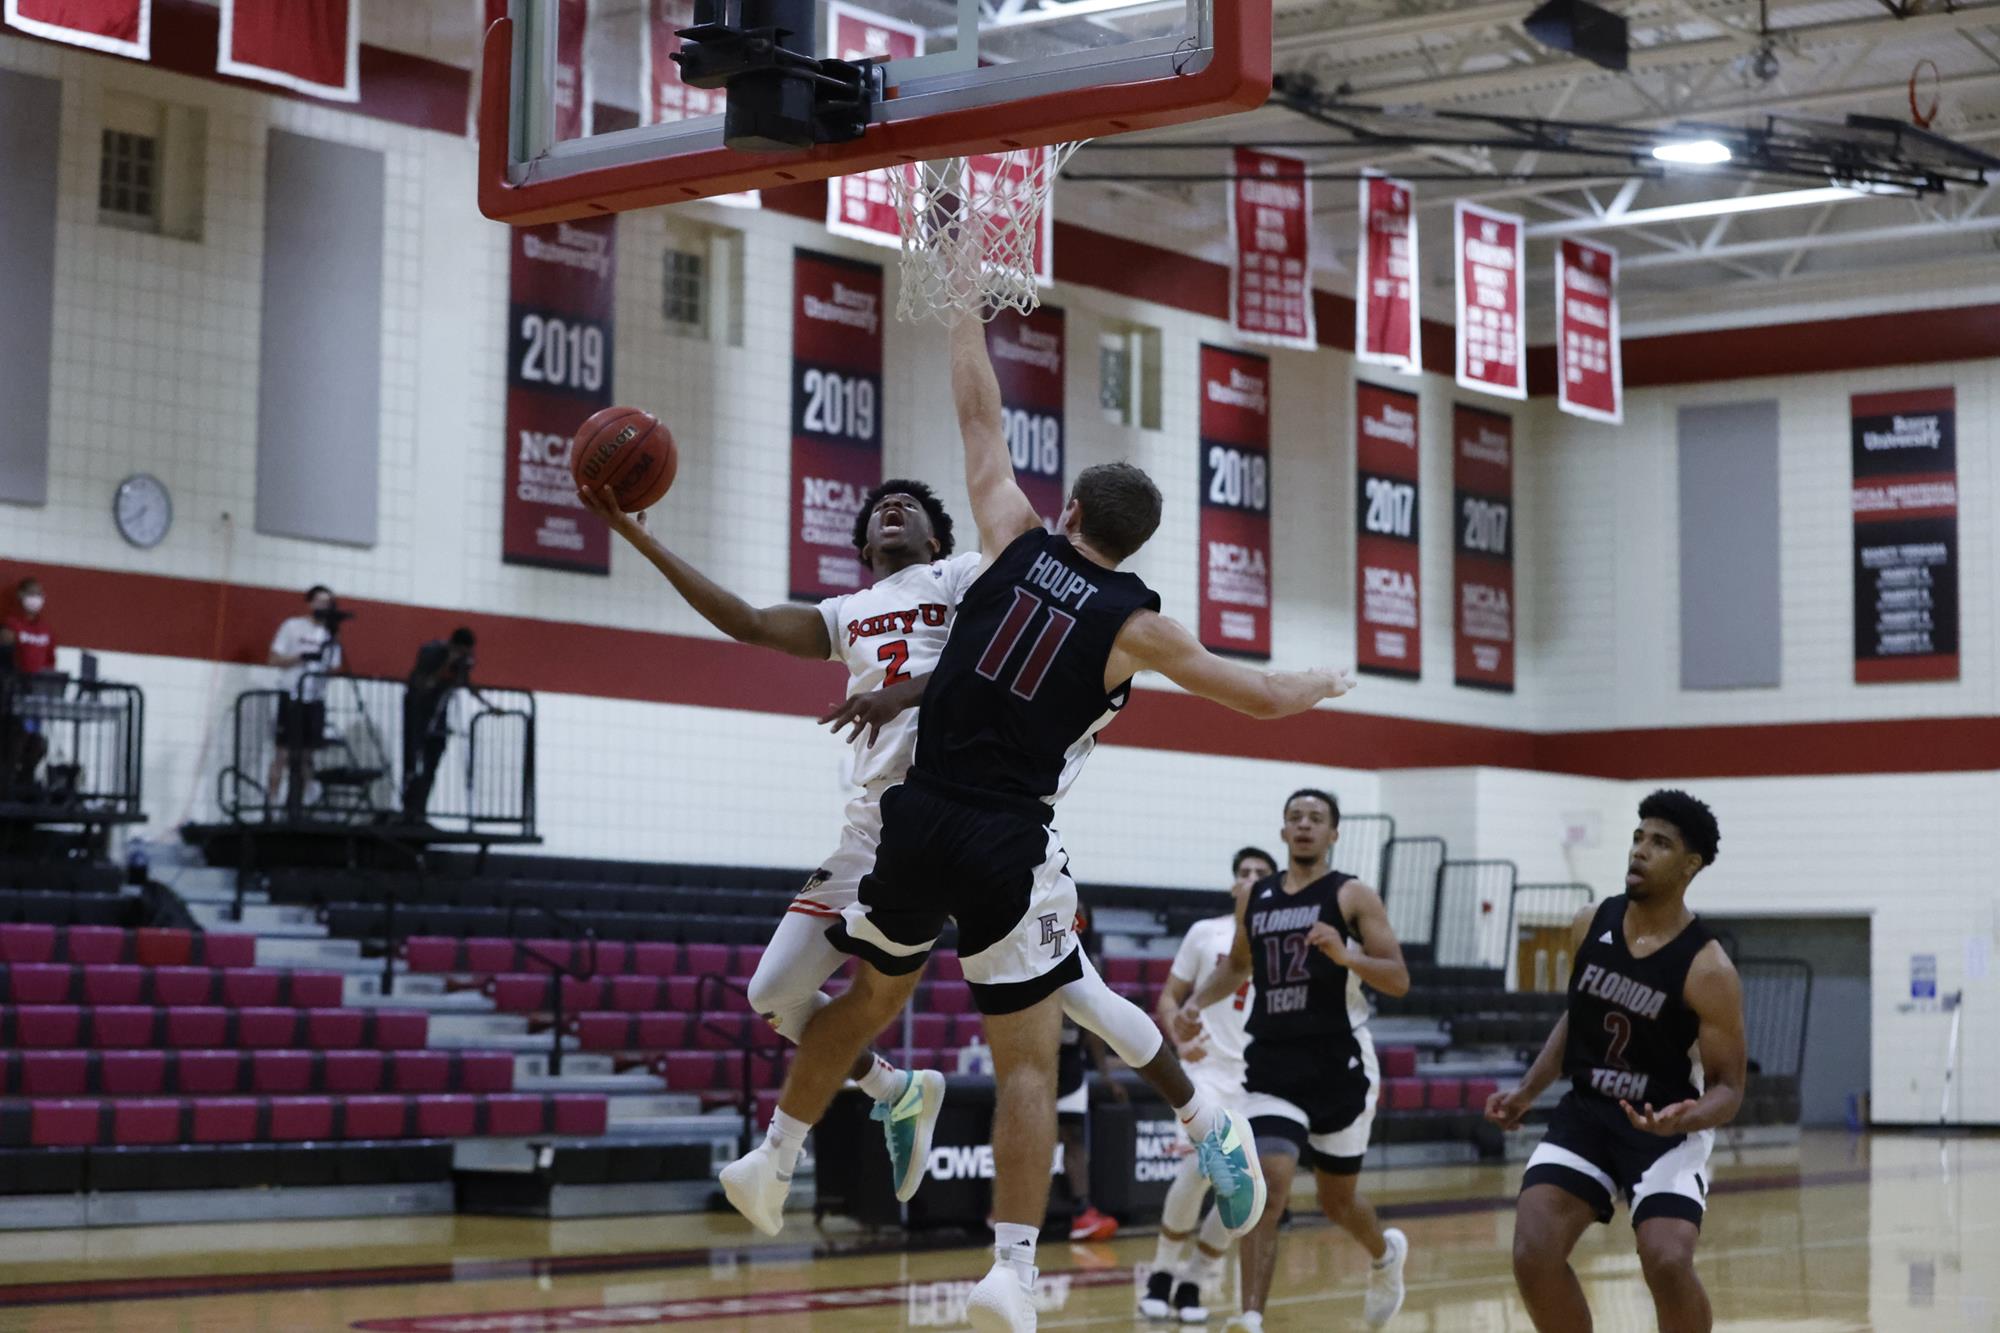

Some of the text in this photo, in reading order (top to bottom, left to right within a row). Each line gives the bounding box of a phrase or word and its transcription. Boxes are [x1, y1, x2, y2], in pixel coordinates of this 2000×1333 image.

[521, 313, 604, 392] 2019
[802, 368, 875, 440] 2019
[584, 424, 638, 481] Wilson
[1209, 446, 1267, 510] 2018
[1366, 478, 1414, 537] 2017
[1463, 499, 1508, 552] 2017
[1024, 551, 1098, 611] HOUPT
[877, 639, 912, 689] 2
[975, 585, 1077, 701] 11
[1037, 912, 1066, 960] FT
[1251, 903, 1322, 939] FLORIDA
[1263, 932, 1311, 986] 12
[1265, 985, 1309, 1015] TECH
[1577, 963, 1668, 1020] FLORIDA
[1603, 1011, 1632, 1070] 2
[1590, 1067, 1649, 1101] TECH
[926, 1144, 996, 1181] OWE
